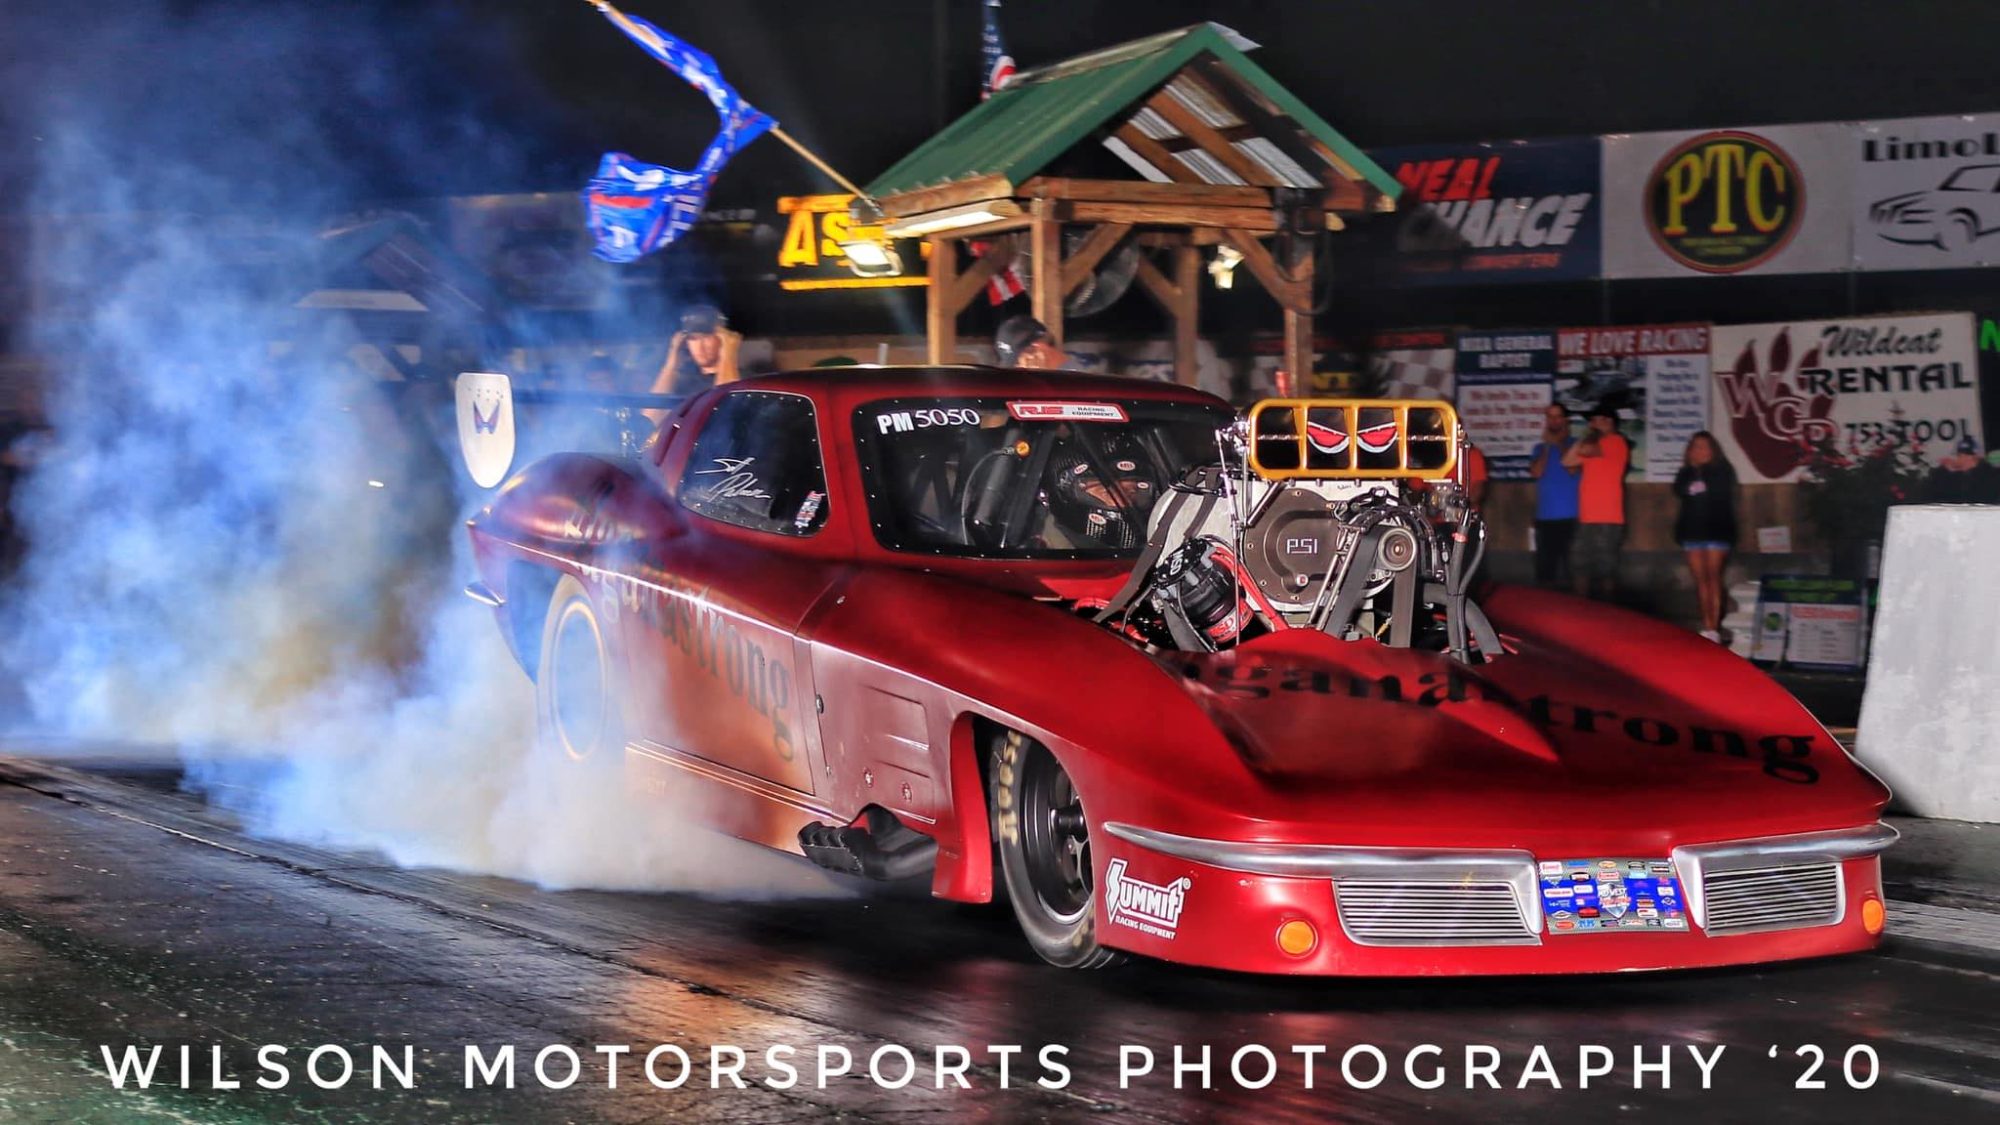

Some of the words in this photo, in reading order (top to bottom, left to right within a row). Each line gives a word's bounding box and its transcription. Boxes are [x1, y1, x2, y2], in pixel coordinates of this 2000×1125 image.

[1396, 157, 1501, 203] NEAL
[1663, 143, 1786, 235] PTC
[1424, 193, 1593, 248] HANCE
[1558, 332, 1588, 355] WE
[1591, 330, 1636, 354] LOVE
[1640, 327, 1707, 352] RACING
[1822, 325, 1942, 357] Wildcat
[1802, 362, 1972, 395] RENTAL
[877, 412, 914, 435] PM
[914, 408, 980, 428] 5050
[1286, 538, 1318, 554] PSI
[1114, 915, 1139, 930] RACING
[1138, 922, 1177, 941] EQUIPMENT
